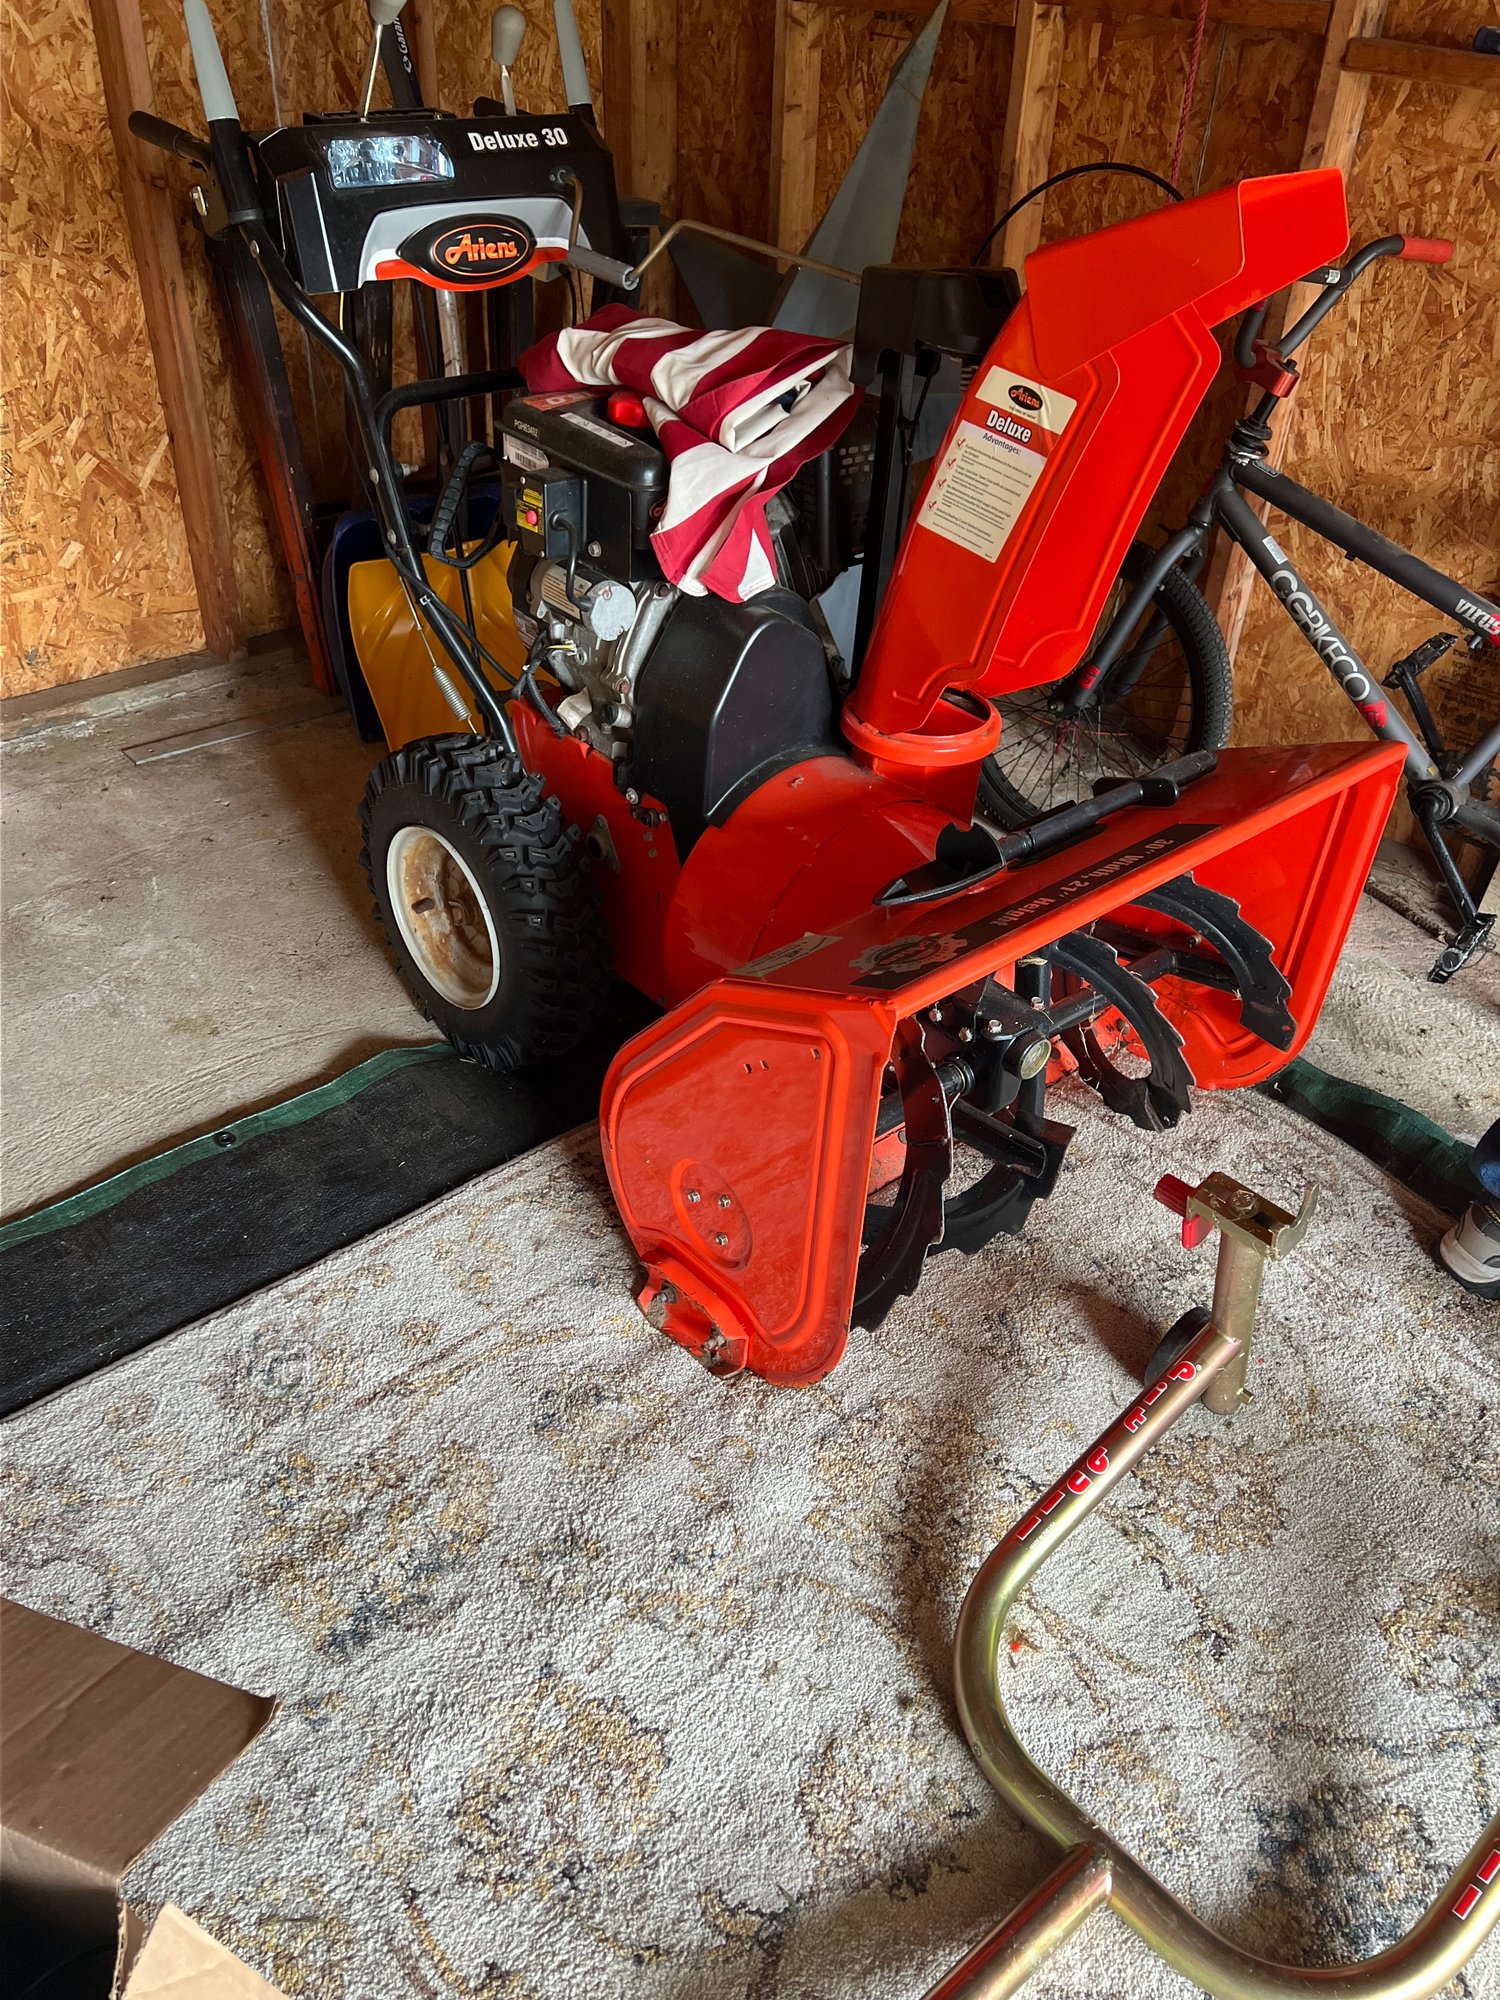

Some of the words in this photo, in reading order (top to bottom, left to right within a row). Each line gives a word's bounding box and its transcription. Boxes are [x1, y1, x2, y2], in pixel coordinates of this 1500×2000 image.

[467, 130, 538, 151] Deluxe
[541, 127, 568, 146] 30
[445, 233, 519, 265] Ariens
[1010, 387, 1040, 408] Ariens
[986, 409, 1031, 443] Deluxe
[982, 433, 1021, 455] Advantages:
[990, 897, 1057, 927] Height
